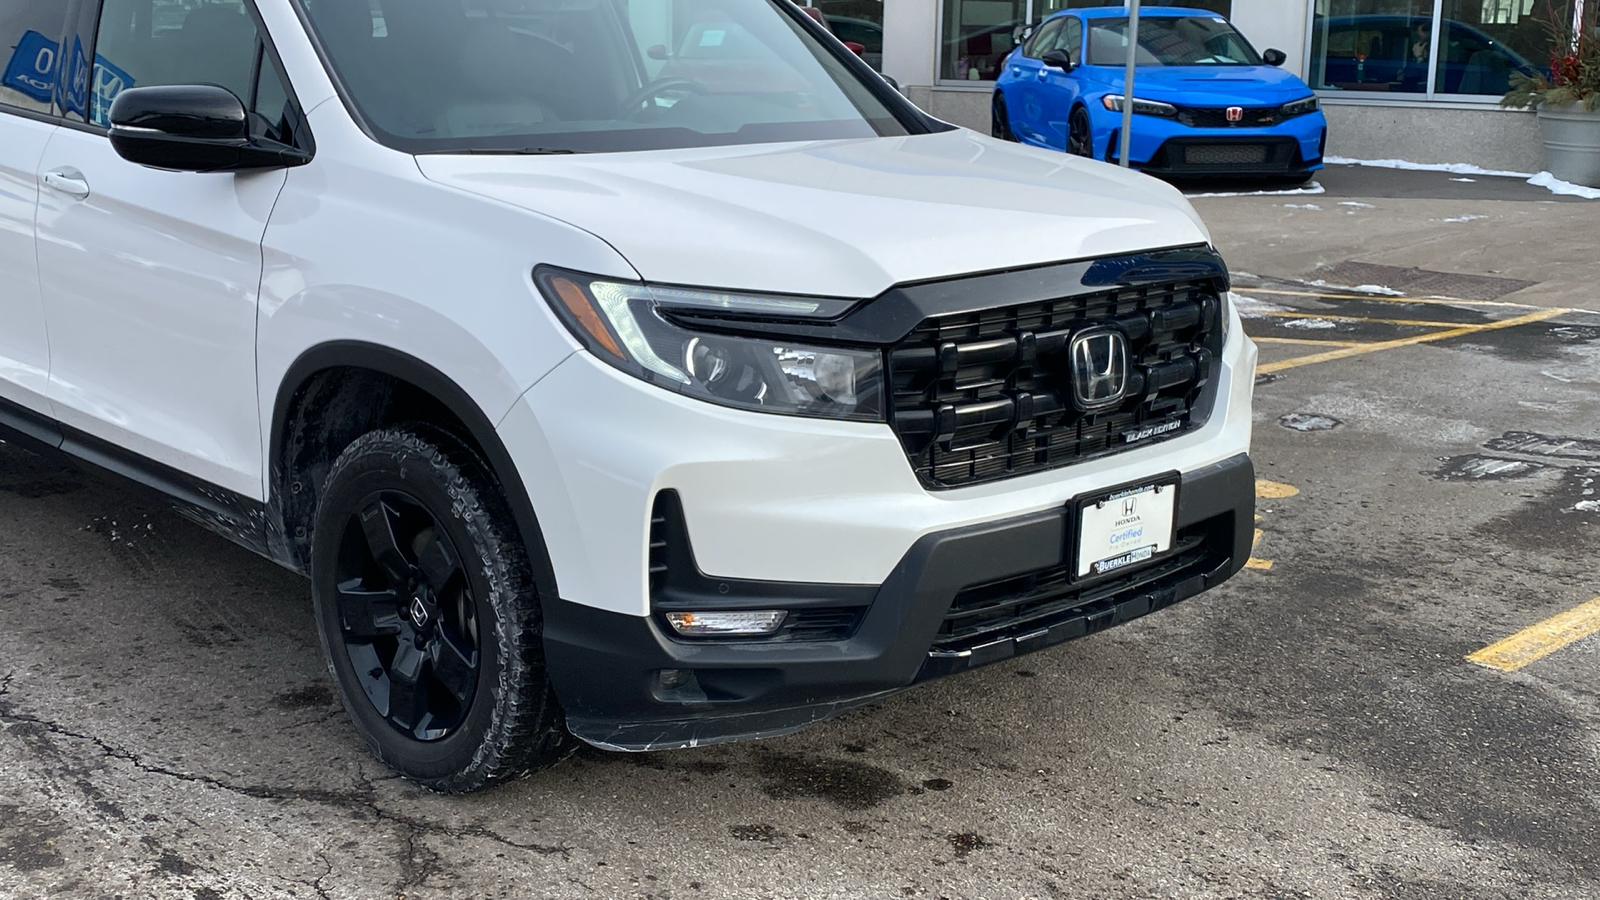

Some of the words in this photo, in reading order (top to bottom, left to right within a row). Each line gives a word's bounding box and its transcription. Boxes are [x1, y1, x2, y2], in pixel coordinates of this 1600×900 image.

[1126, 428, 1152, 442] BLACK
[1153, 420, 1180, 434] EDITION
[1115, 516, 1140, 526] HONDA
[1110, 526, 1142, 544] Certified
